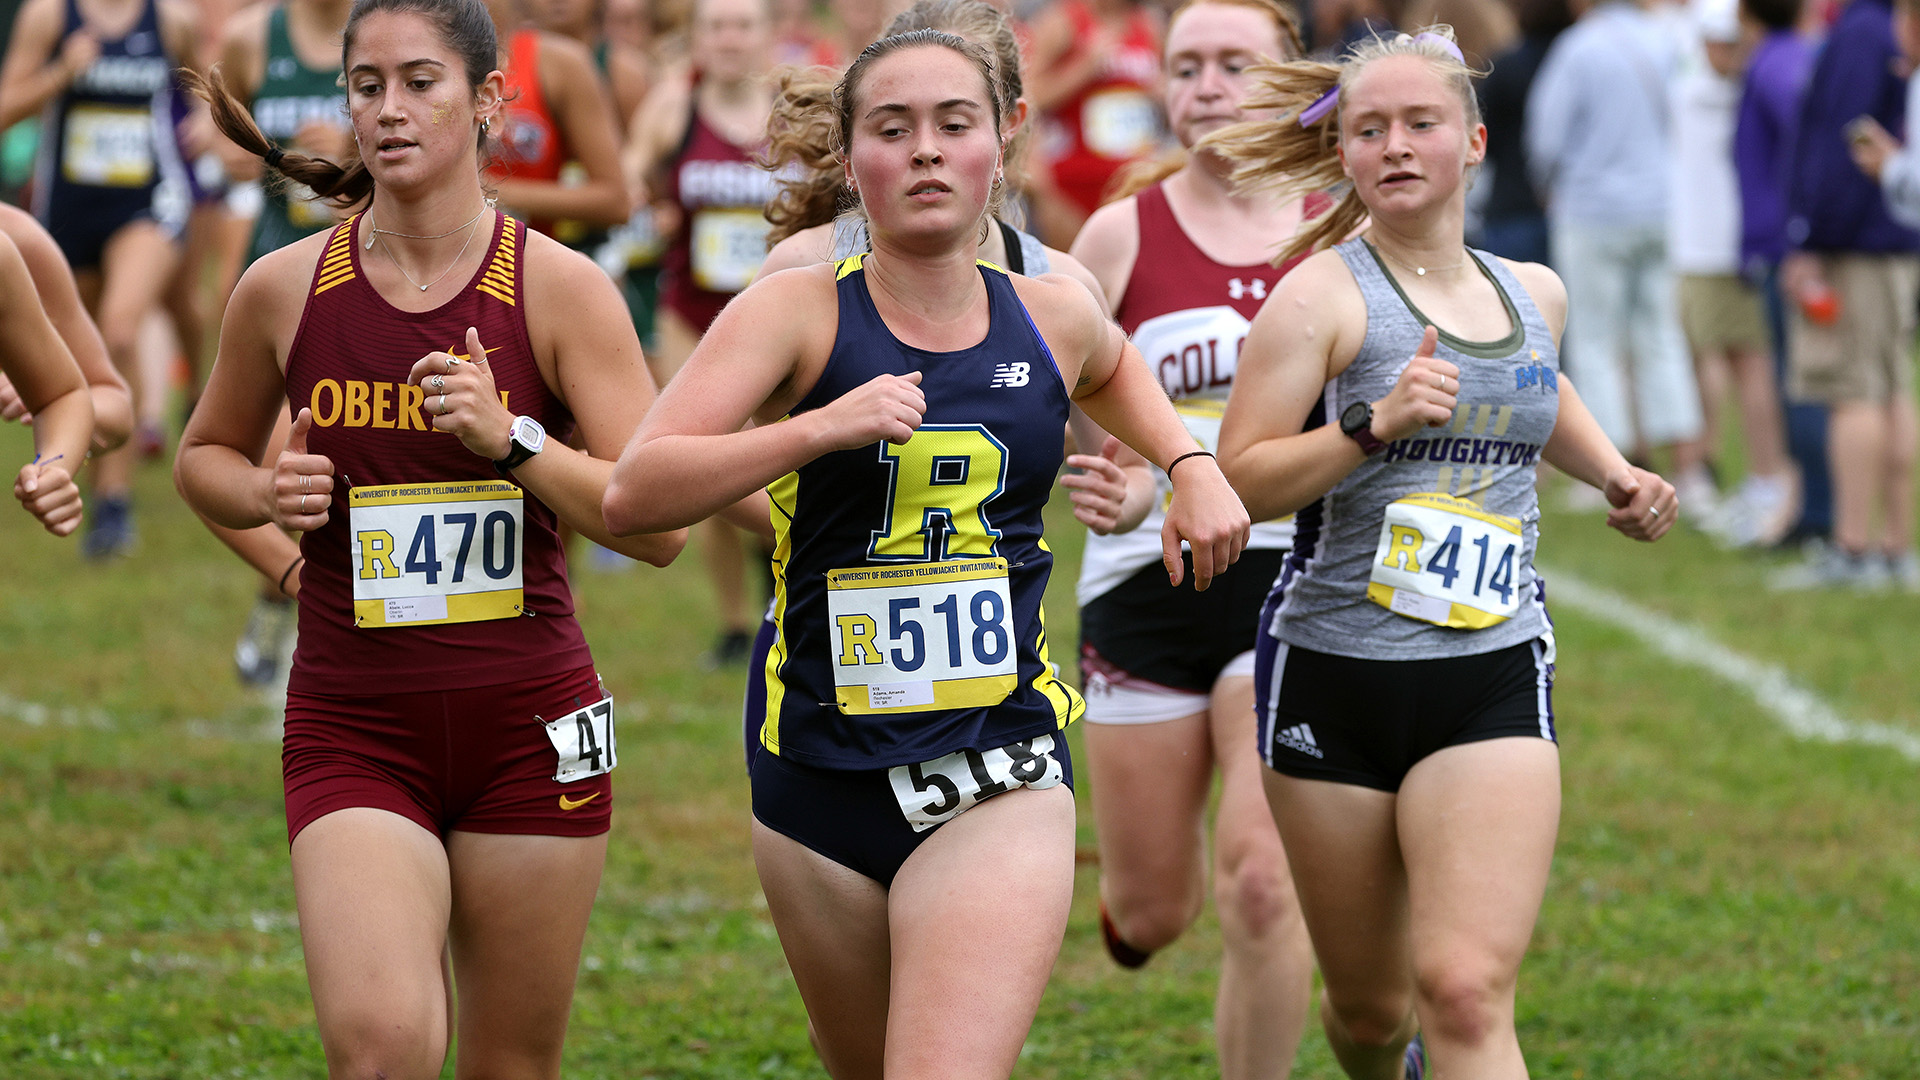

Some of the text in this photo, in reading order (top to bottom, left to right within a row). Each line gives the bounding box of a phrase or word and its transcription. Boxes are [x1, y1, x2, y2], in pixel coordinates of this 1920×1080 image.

[990, 361, 1031, 389] NB
[310, 378, 510, 433] OBER
[1384, 437, 1542, 468] HOUGHTON
[360, 483, 513, 499] UNIVERSITY OF ROCHESTER YELLOWJACKET INVITATIONAL
[866, 423, 1010, 562] R
[357, 510, 516, 585] R 470
[1382, 523, 1516, 606] R 414
[838, 561, 998, 582] UNIVERSITY OF ROCHESTER YELLOWJACKET INVITATIONAL
[836, 589, 1009, 673] R 518
[1275, 732, 1324, 760] adidas
